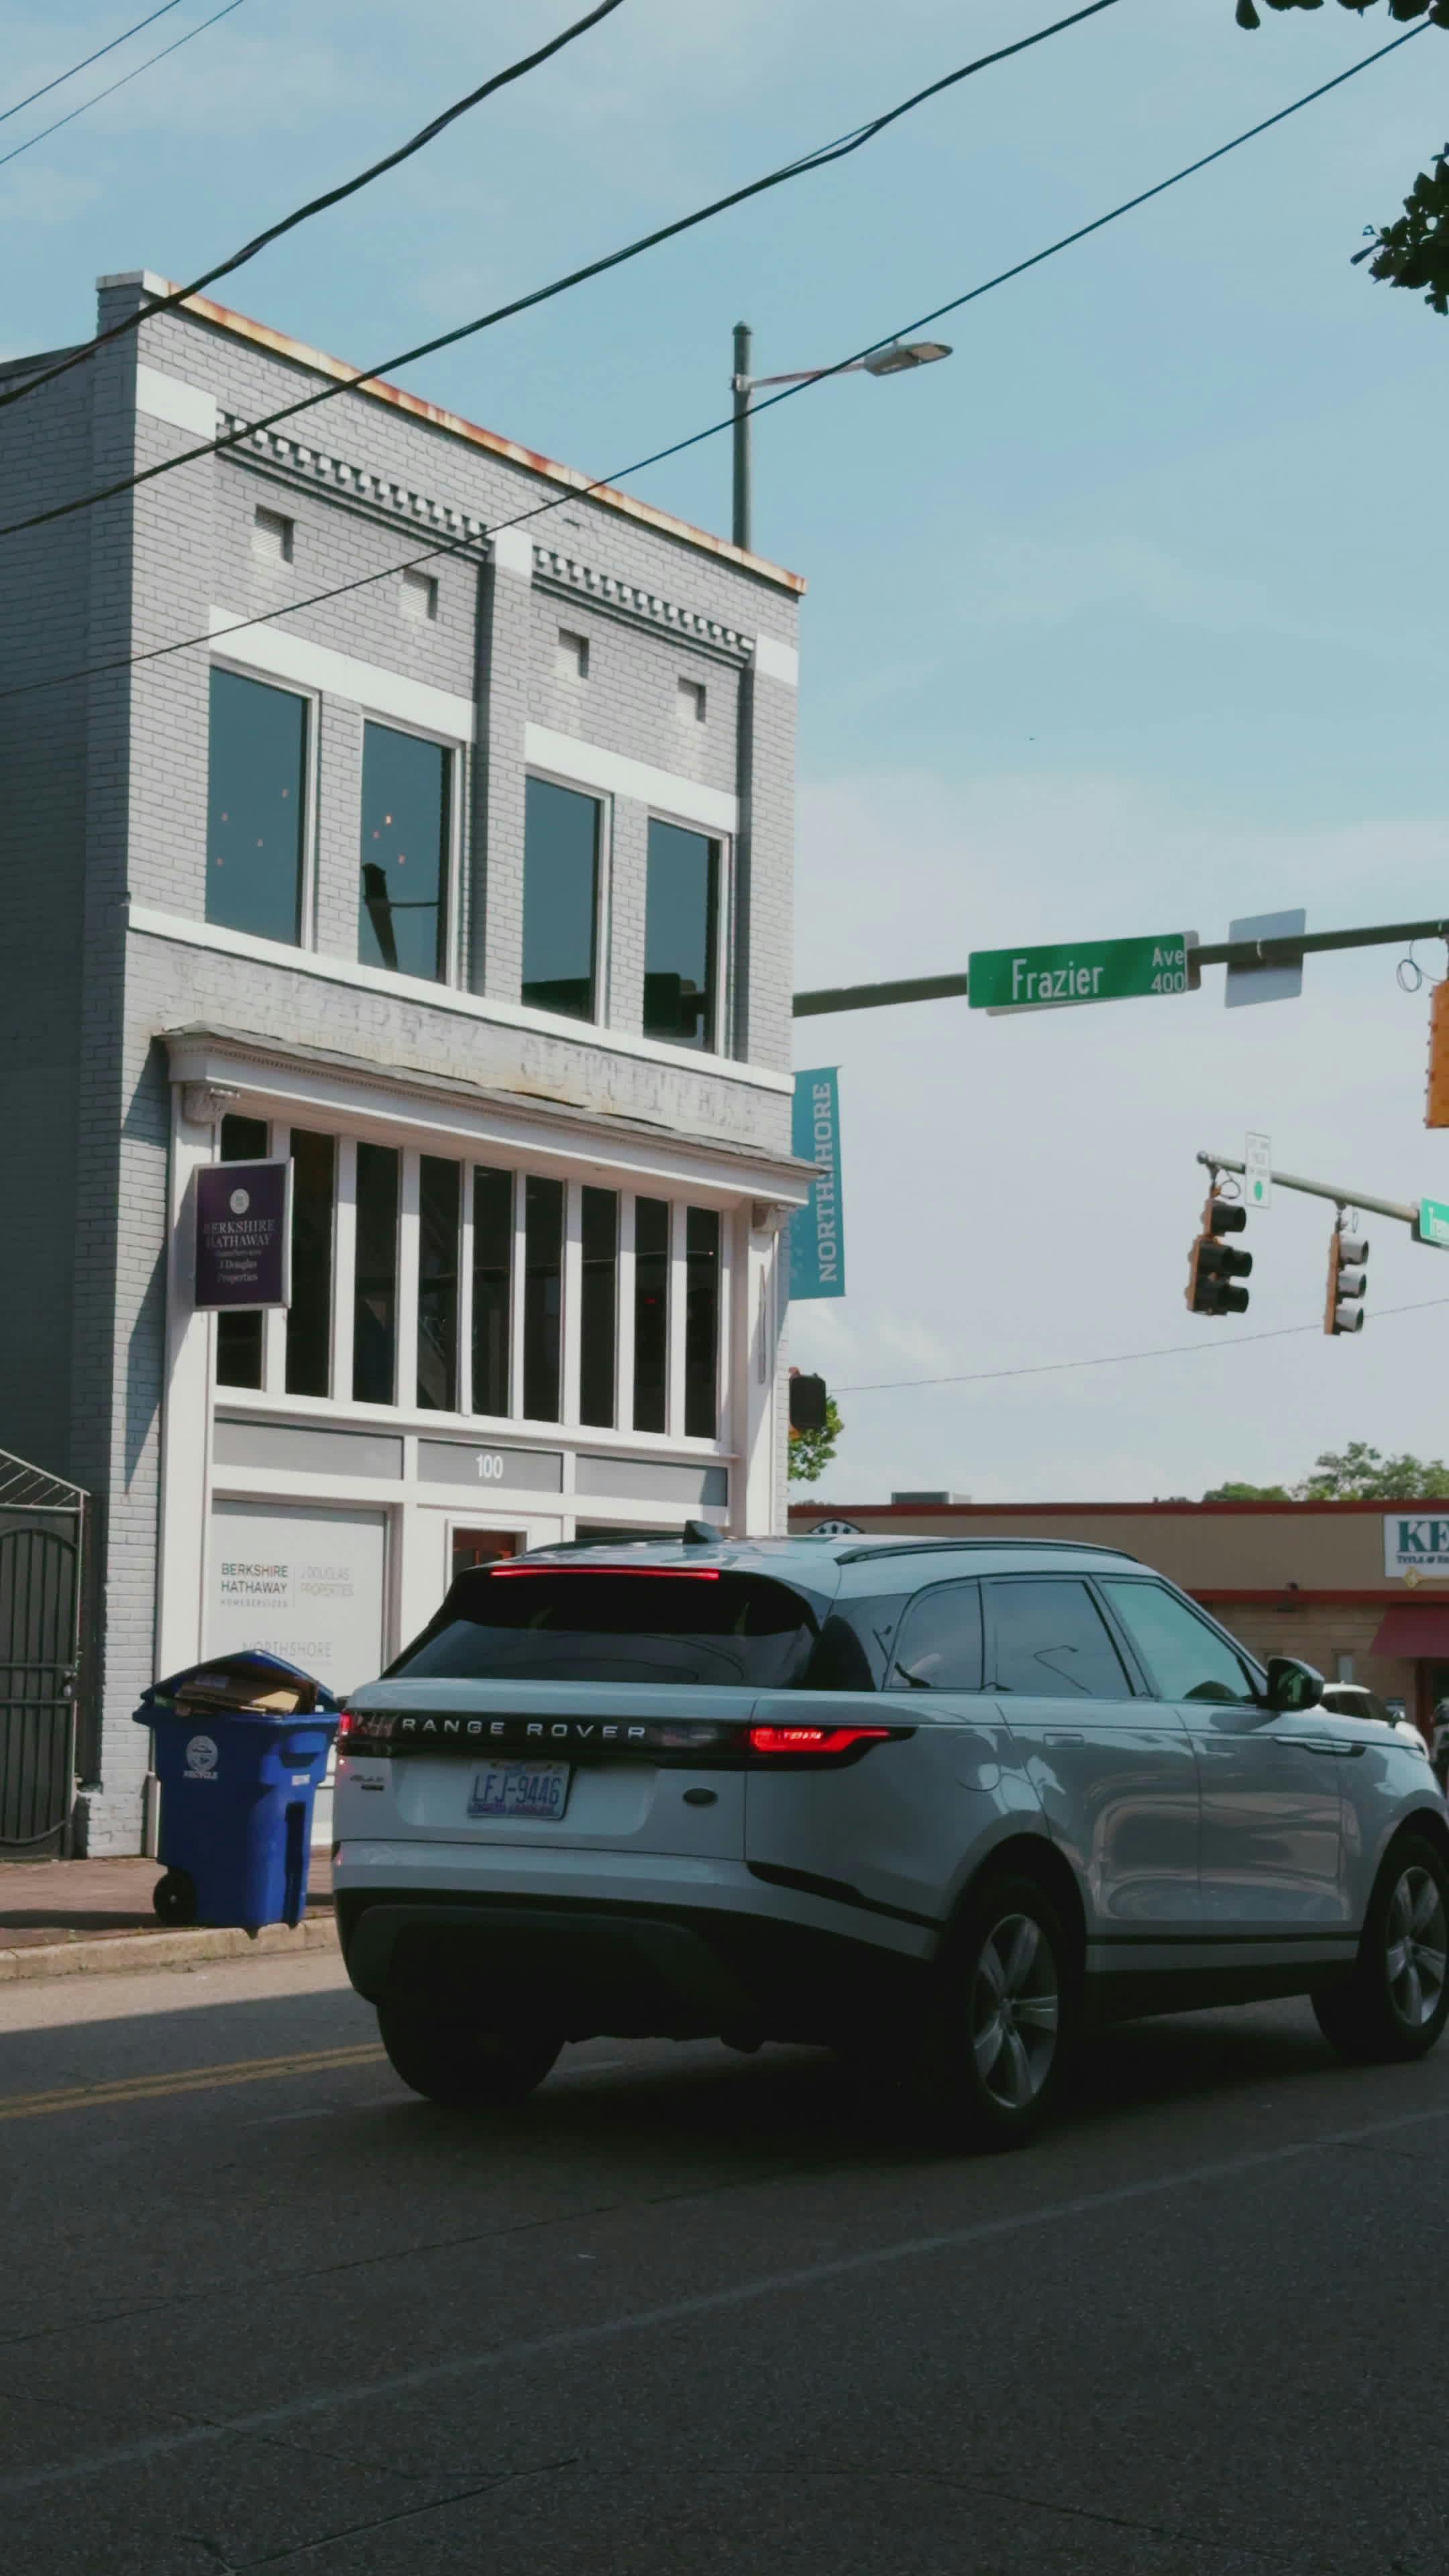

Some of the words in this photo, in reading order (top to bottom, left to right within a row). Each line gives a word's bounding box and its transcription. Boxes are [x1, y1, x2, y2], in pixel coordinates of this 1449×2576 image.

[1152, 947, 1185, 967] Ave
[1012, 958, 1104, 1000] Frazier
[1150, 972, 1185, 993] 400
[203, 1219, 275, 1234] BERKSHIRE
[205, 1234, 271, 1248] HATHAWAY
[476, 1454, 503, 1478] 100
[1397, 1521, 1449, 1552] KE
[221, 1562, 288, 1577] BERKSHIRE
[221, 1580, 288, 1595] HATHAWAY
[402, 1718, 504, 1734] RANGE
[527, 1724, 645, 1739] ROVER
[472, 1774, 561, 1805] LFJ-9446
